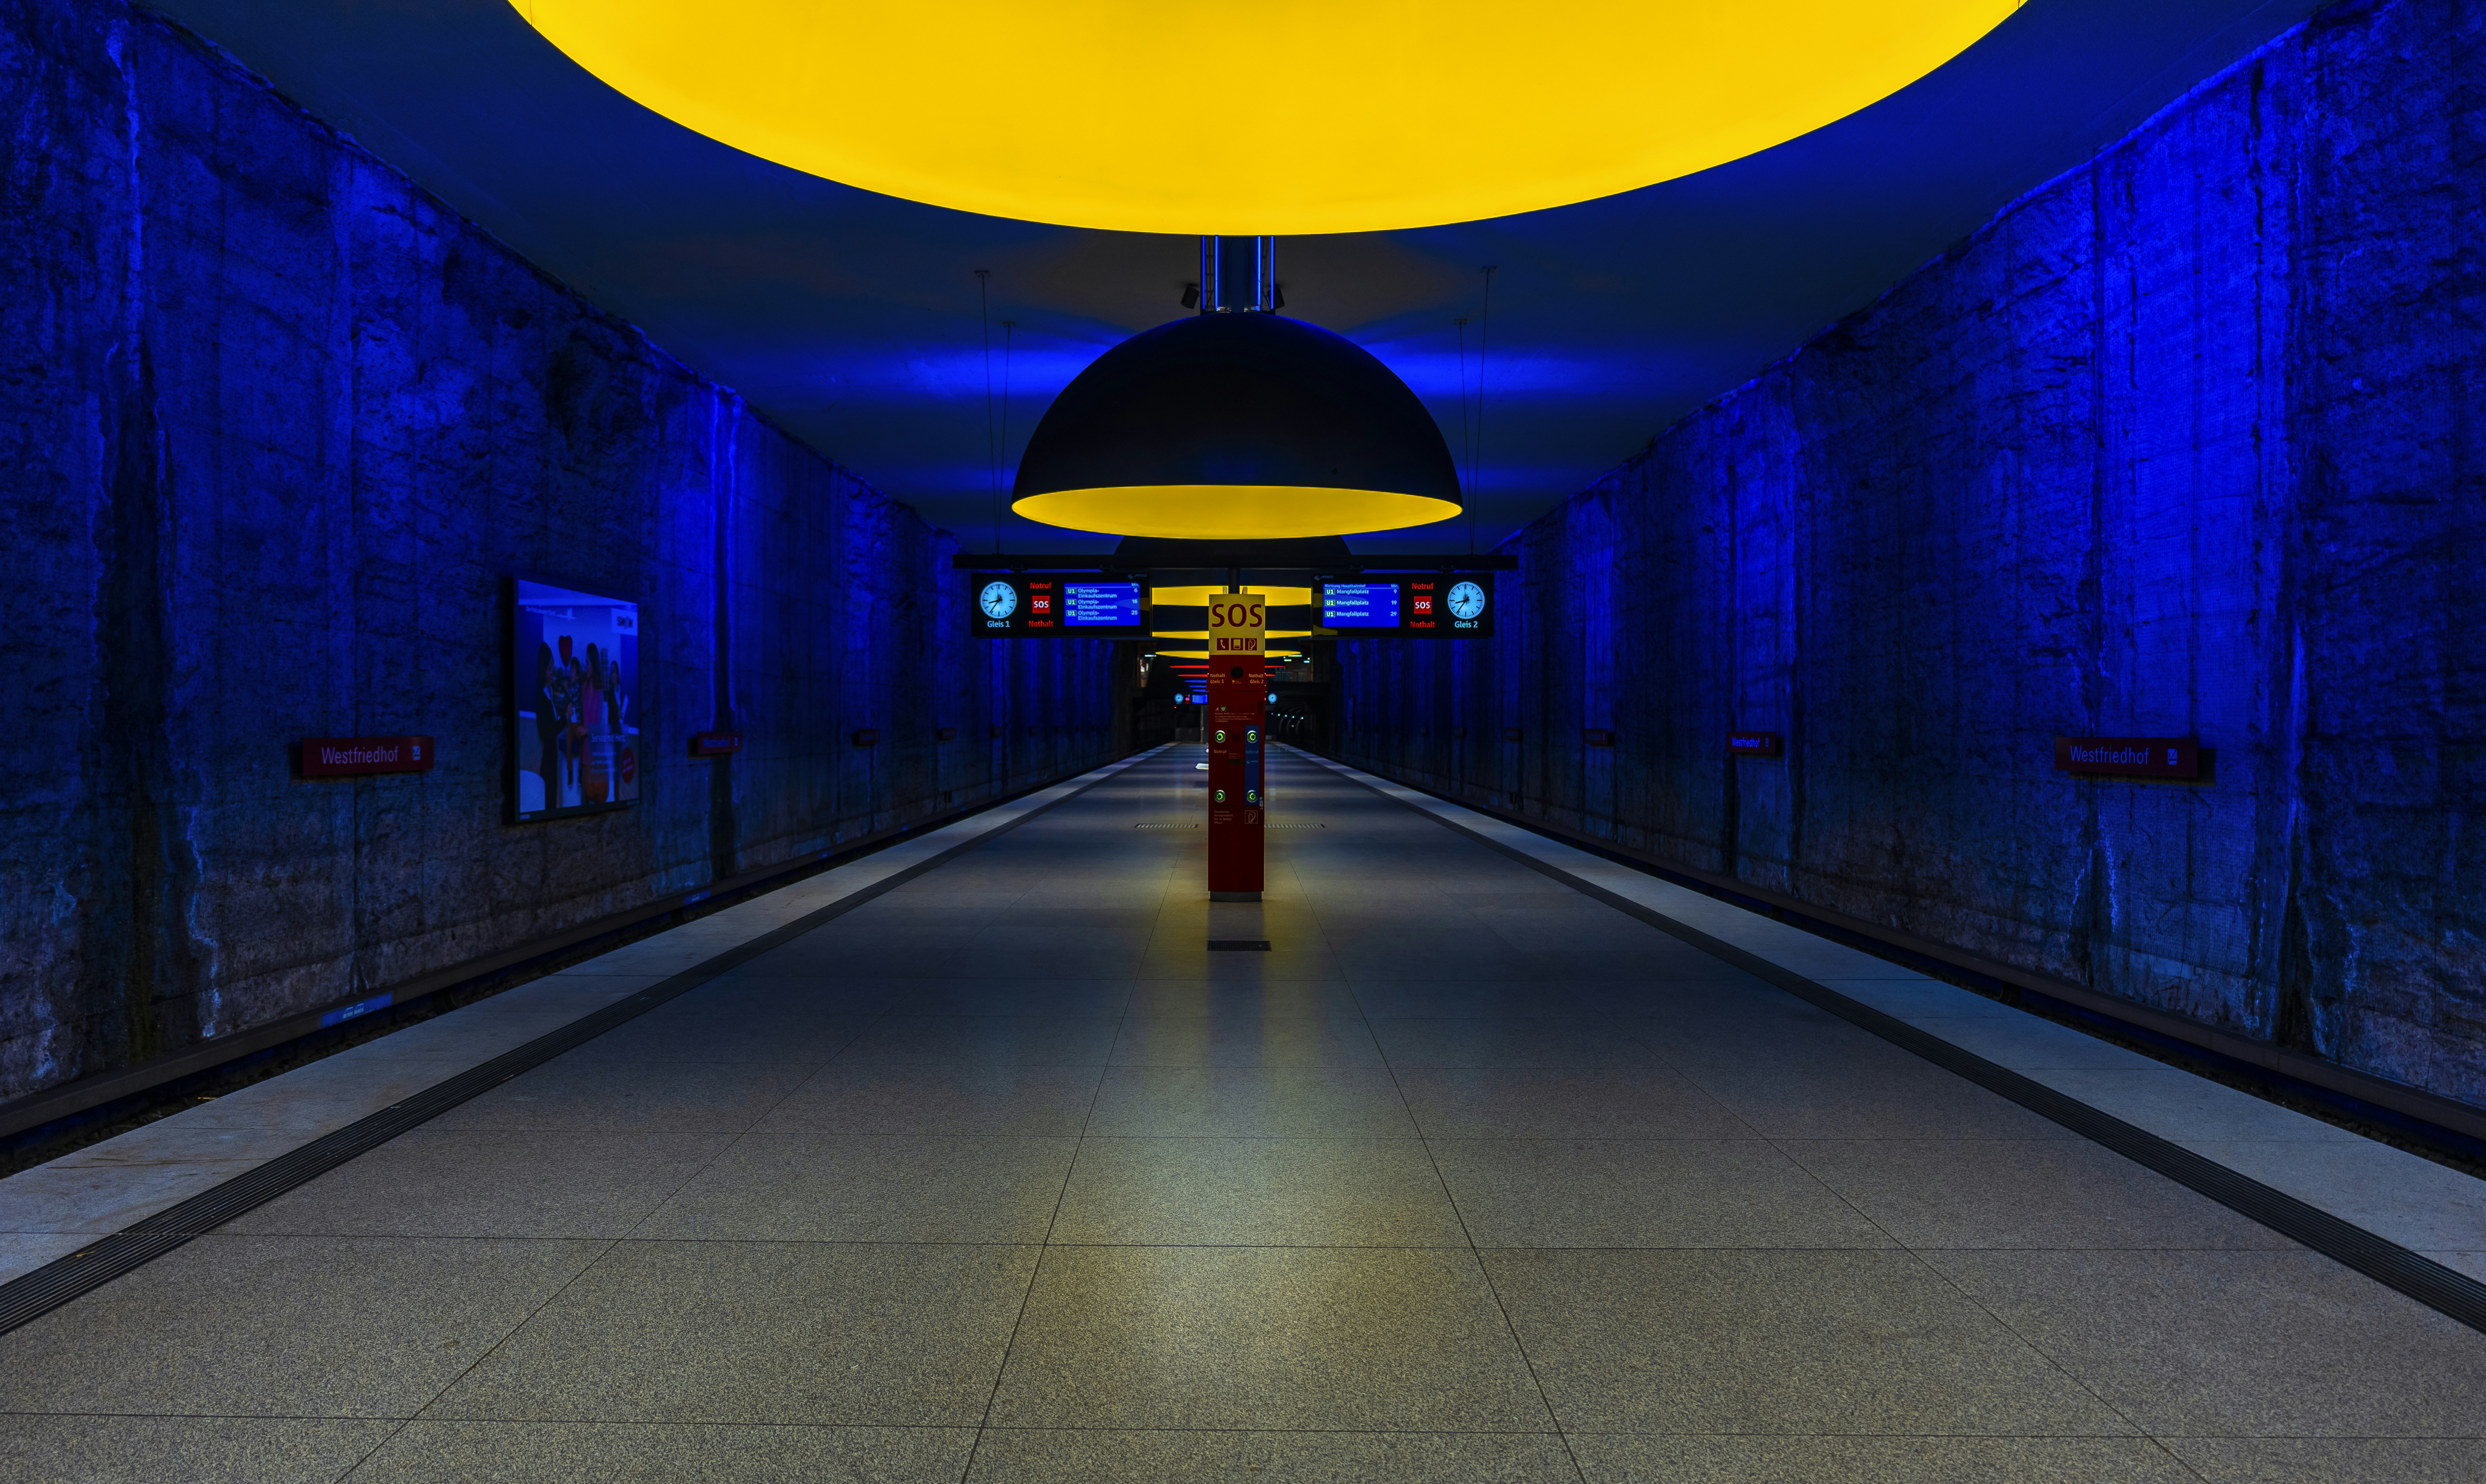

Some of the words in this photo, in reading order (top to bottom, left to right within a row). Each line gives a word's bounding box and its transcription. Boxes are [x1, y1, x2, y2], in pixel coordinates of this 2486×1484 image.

[1212, 604, 1263, 627] SOS
[1731, 736, 1760, 748] Westfriedhof
[321, 746, 399, 765] Westfriedhof
[2070, 745, 2149, 765] Westfriedhof
